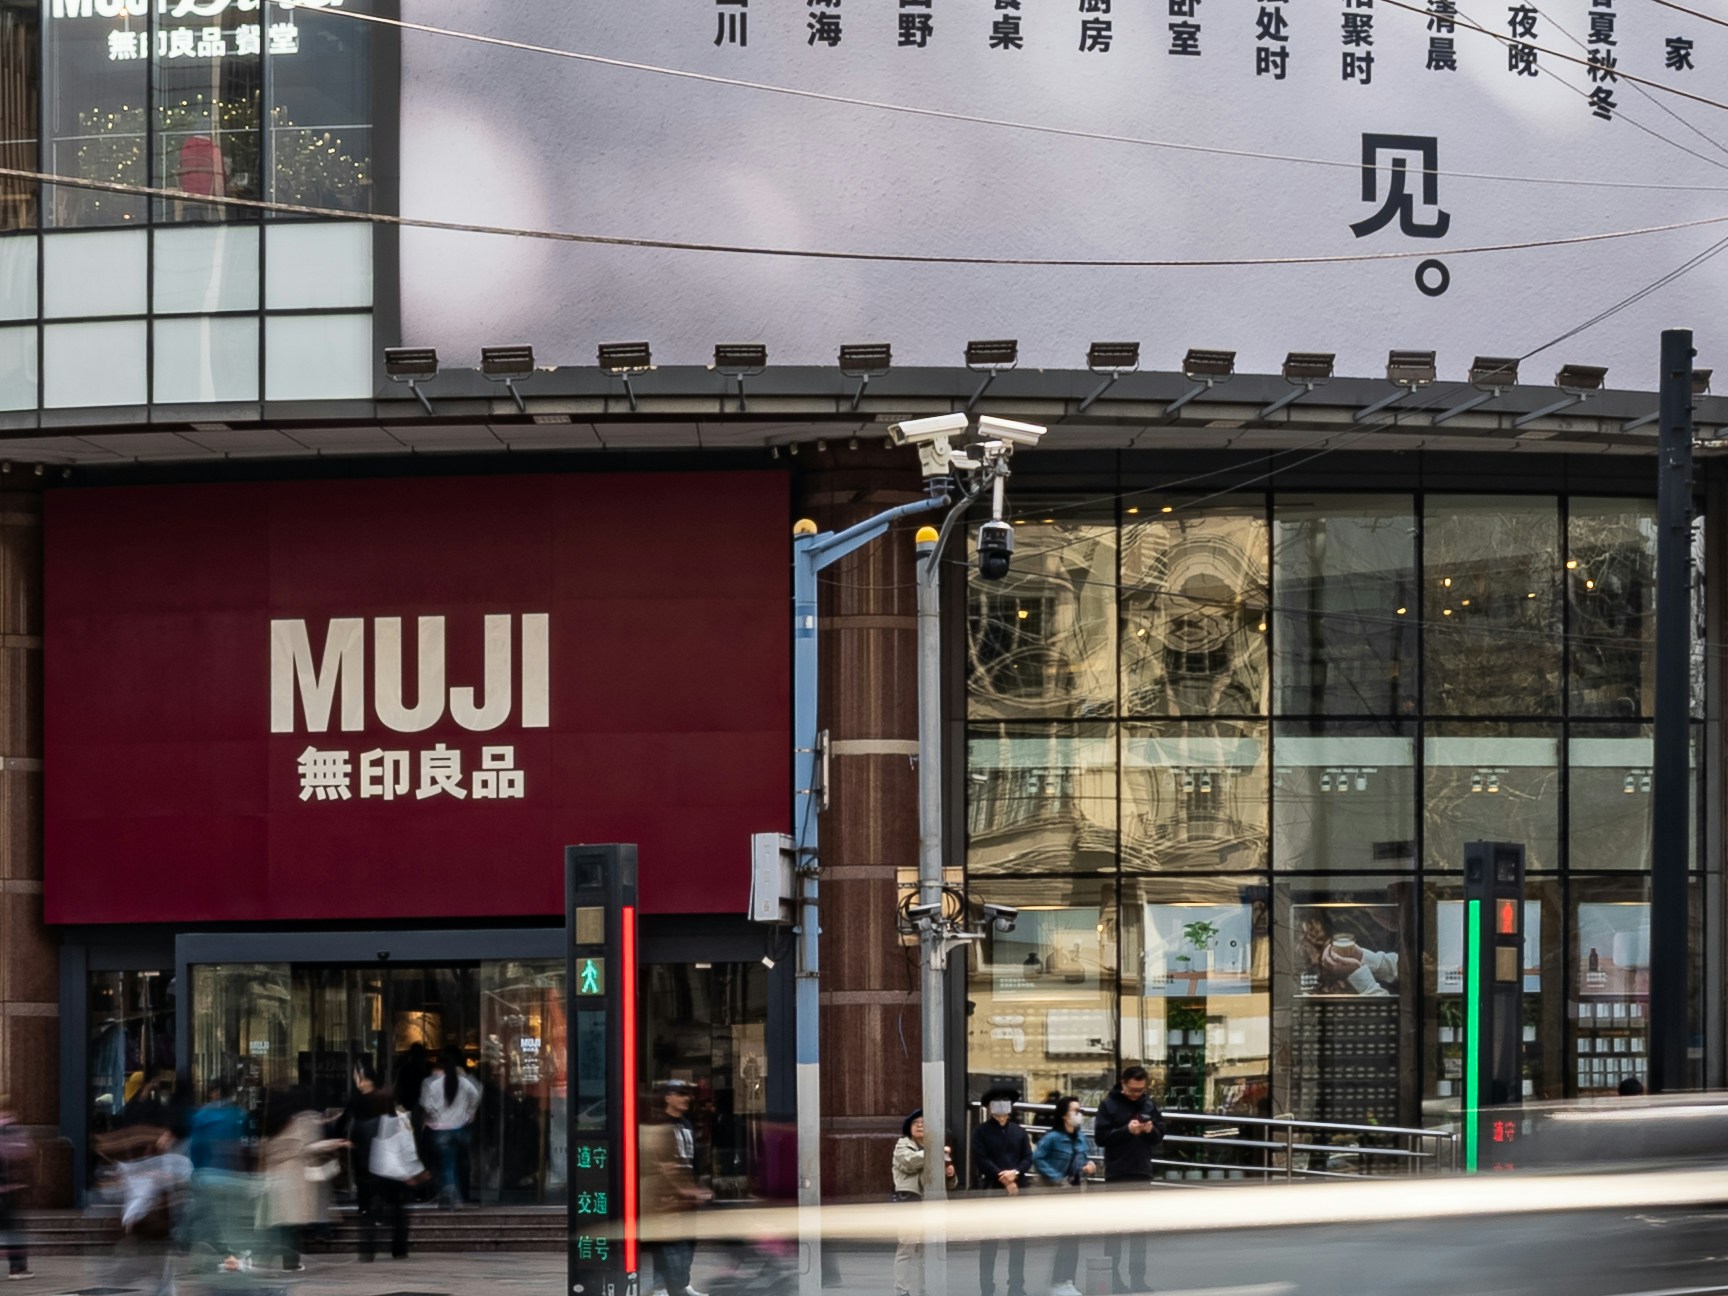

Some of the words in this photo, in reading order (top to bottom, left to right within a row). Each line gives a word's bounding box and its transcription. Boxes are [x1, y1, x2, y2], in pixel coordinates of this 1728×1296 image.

[1508, 4, 1539, 77] 夜晚
[1665, 37, 1694, 72] 家
[271, 613, 550, 733] MUJI
[297, 743, 524, 802] 無印良品
[577, 1191, 608, 1215] 交通
[577, 1235, 610, 1261] 信号
